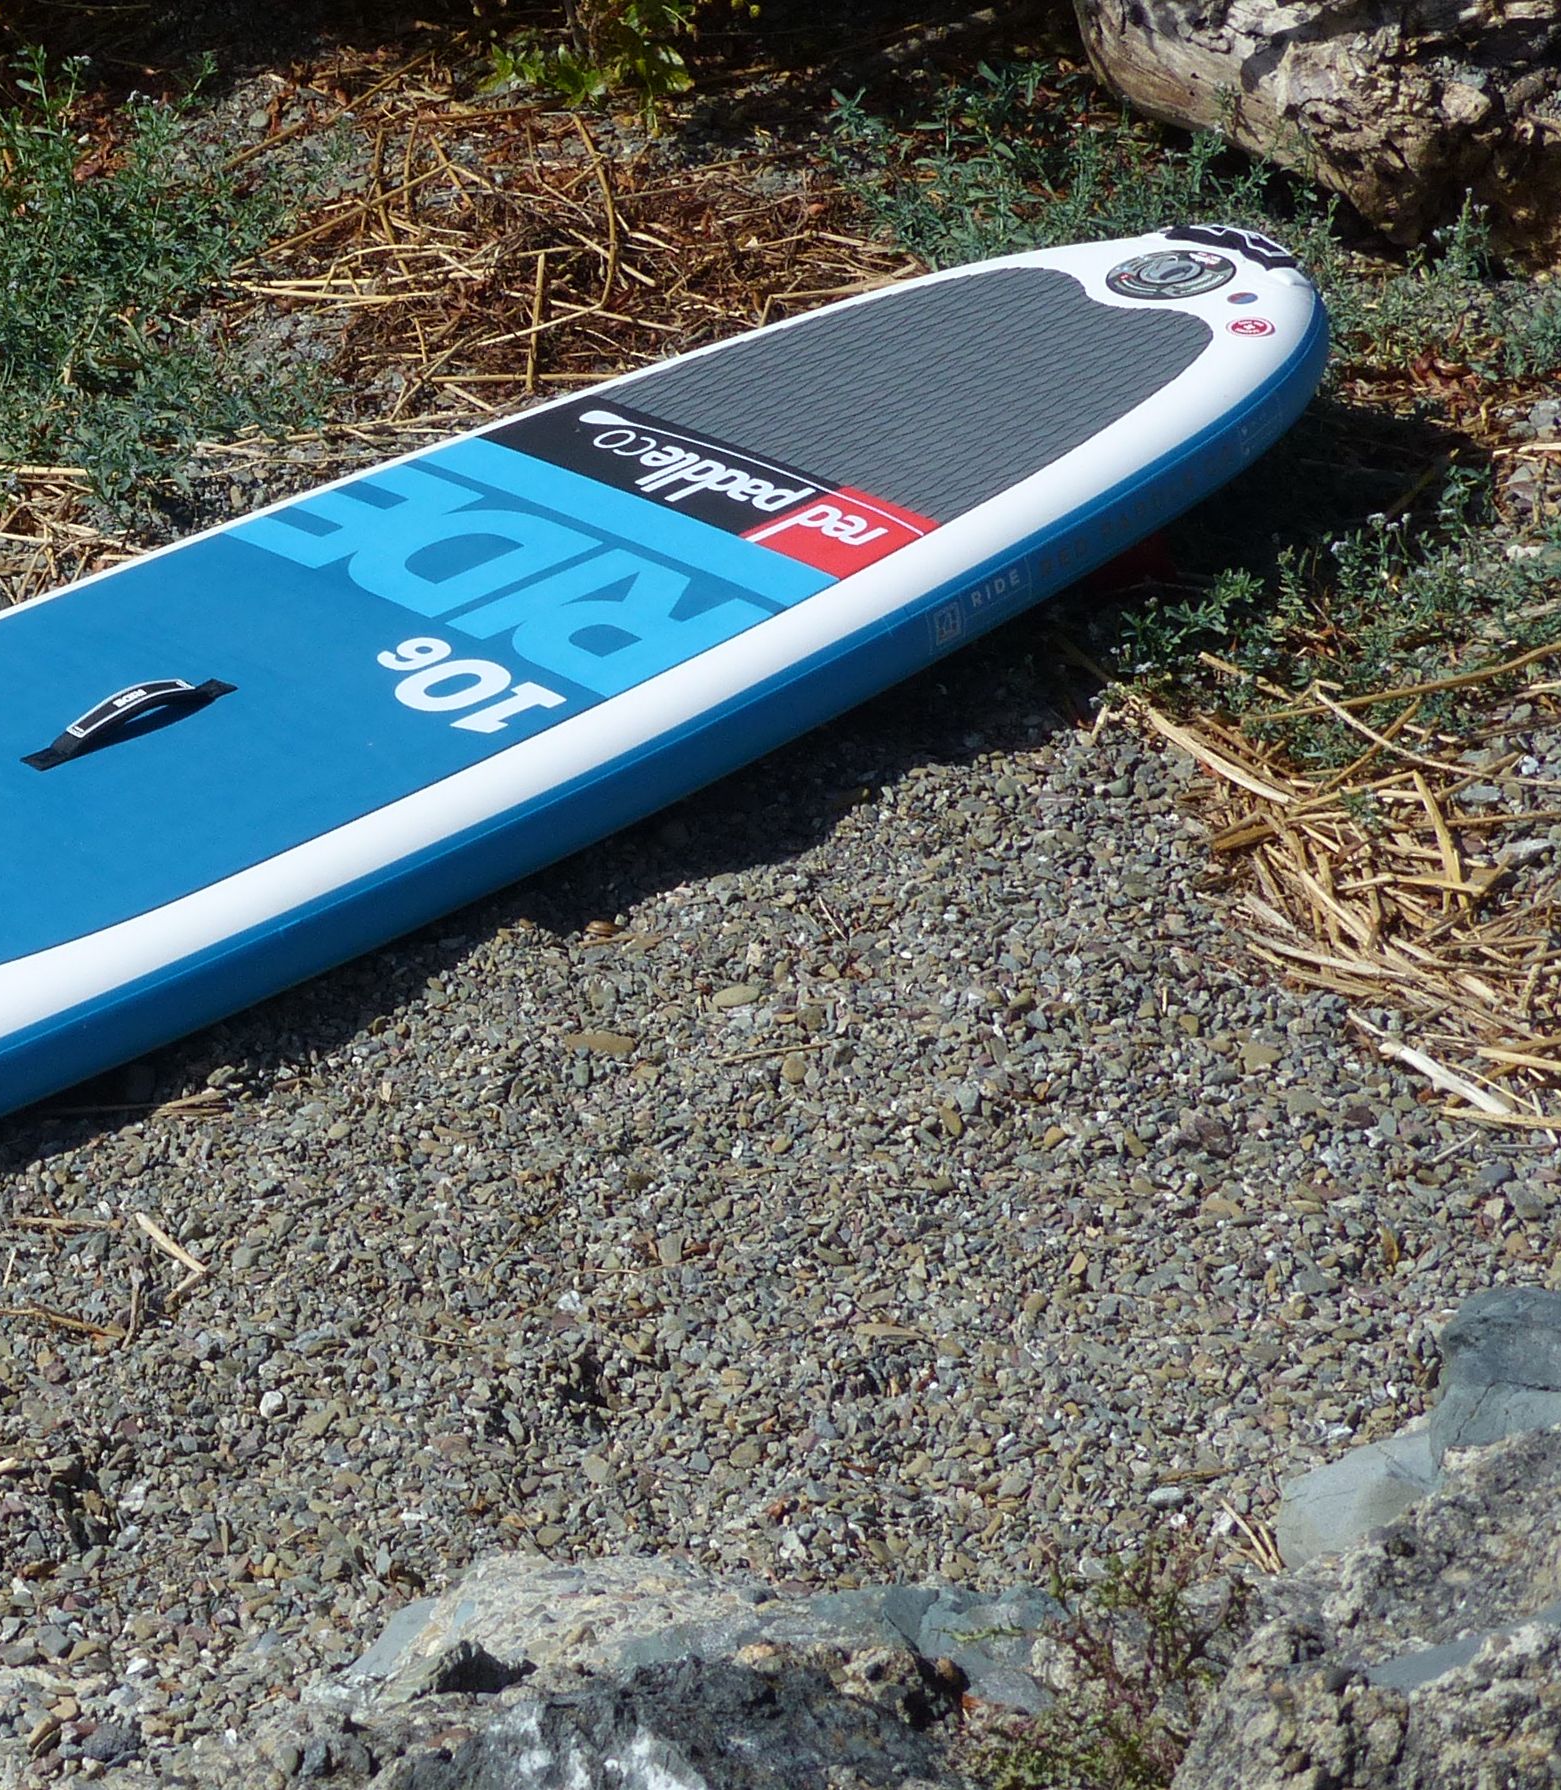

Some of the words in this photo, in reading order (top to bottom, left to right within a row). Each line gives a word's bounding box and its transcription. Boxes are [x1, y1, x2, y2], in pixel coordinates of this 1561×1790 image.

[742, 503, 890, 546] red
[223, 464, 775, 698] RIDE
[970, 567, 1021, 608] RIDE
